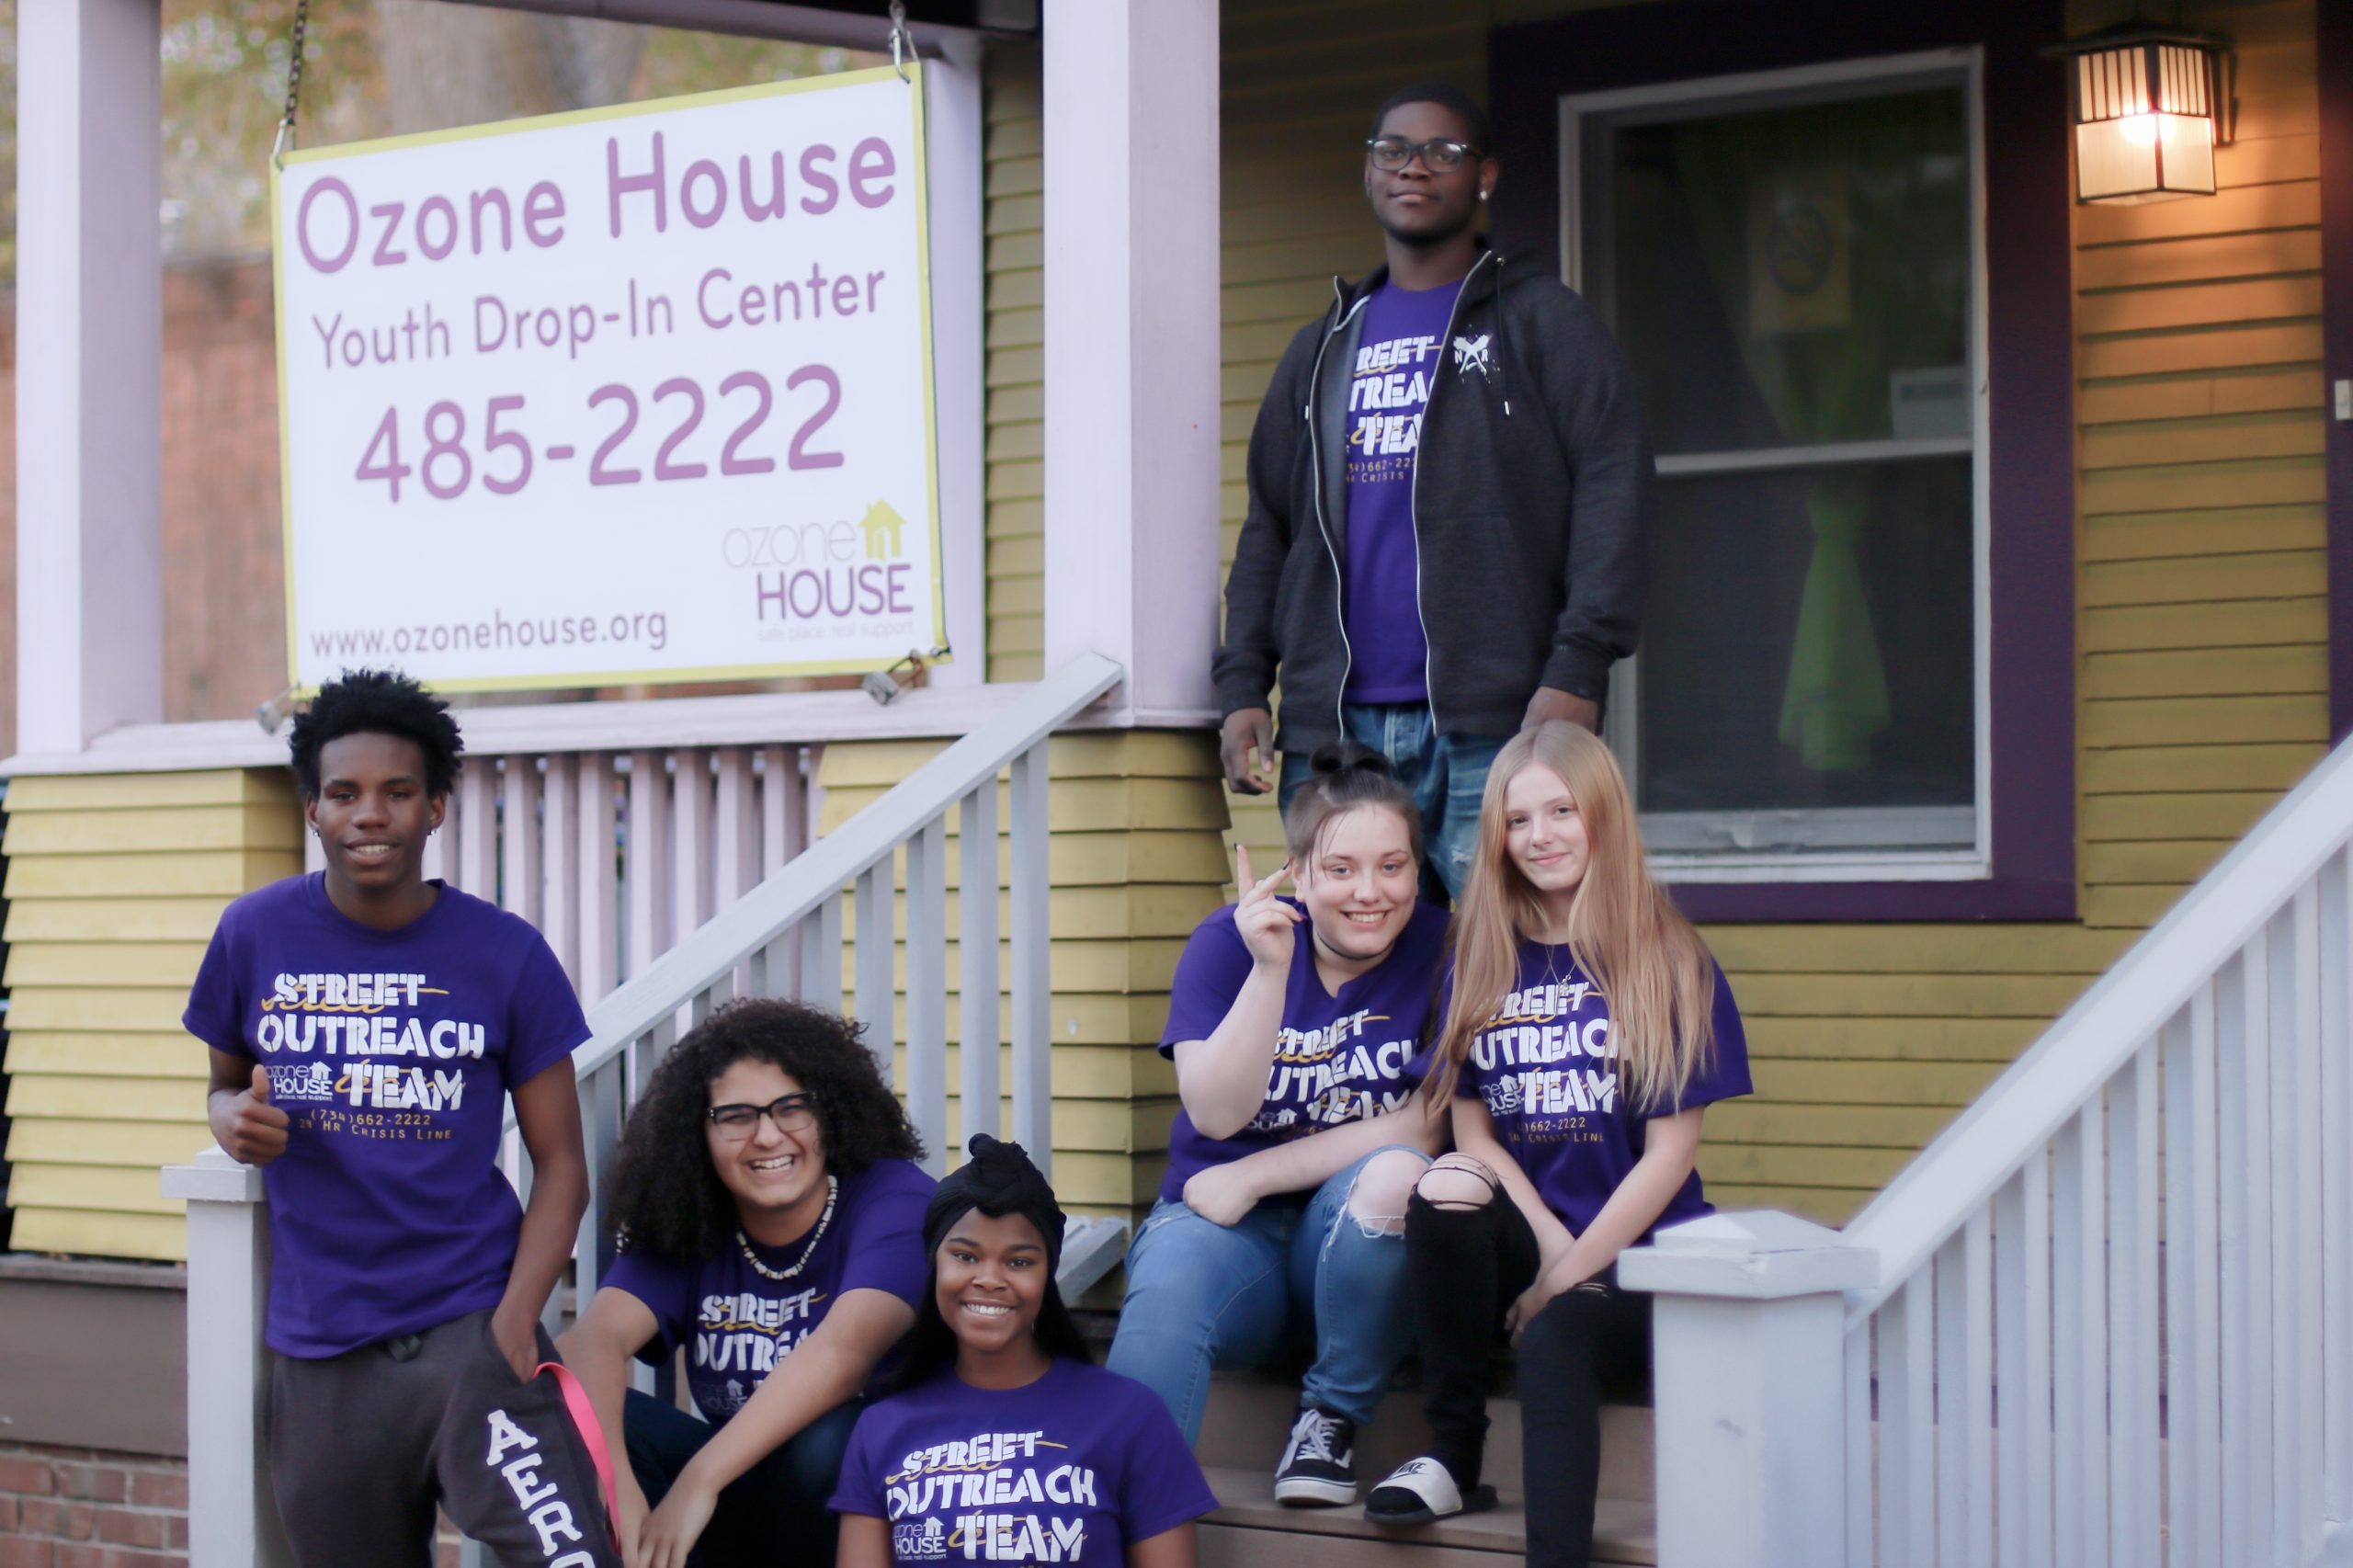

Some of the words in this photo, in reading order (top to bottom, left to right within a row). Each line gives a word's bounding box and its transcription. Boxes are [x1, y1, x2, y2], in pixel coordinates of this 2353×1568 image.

[297, 176, 566, 274] Ozone
[607, 131, 897, 239] House
[313, 302, 451, 369] Youth
[474, 278, 674, 360] Drop-In
[697, 262, 885, 330] Center
[1356, 335, 1435, 371] REET
[1348, 371, 1432, 411] TREA
[355, 363, 845, 504] 485-2222
[1358, 414, 1423, 456] TEA
[722, 520, 857, 568] ozone
[756, 562, 914, 621] HOUSE
[311, 608, 667, 656] www.ozonehouse.org
[272, 972, 426, 1006] STREET
[1490, 982, 1589, 1020] REET
[256, 1013, 485, 1059] OUTREACH
[265, 1064, 310, 1078] ozone
[273, 1077, 334, 1096] HOUSE
[342, 1062, 463, 1111] TEAM
[1265, 1039, 1417, 1102] UTREAC
[1518, 1069, 1617, 1114] TEAM
[698, 1287, 816, 1327] STREET
[694, 1327, 810, 1372] OUTRE
[898, 1430, 1043, 1477] STREET
[885, 1464, 1097, 1522] OUTREACH
[894, 1536, 947, 1555] HOUSE
[955, 1514, 1084, 1562] TEAM
